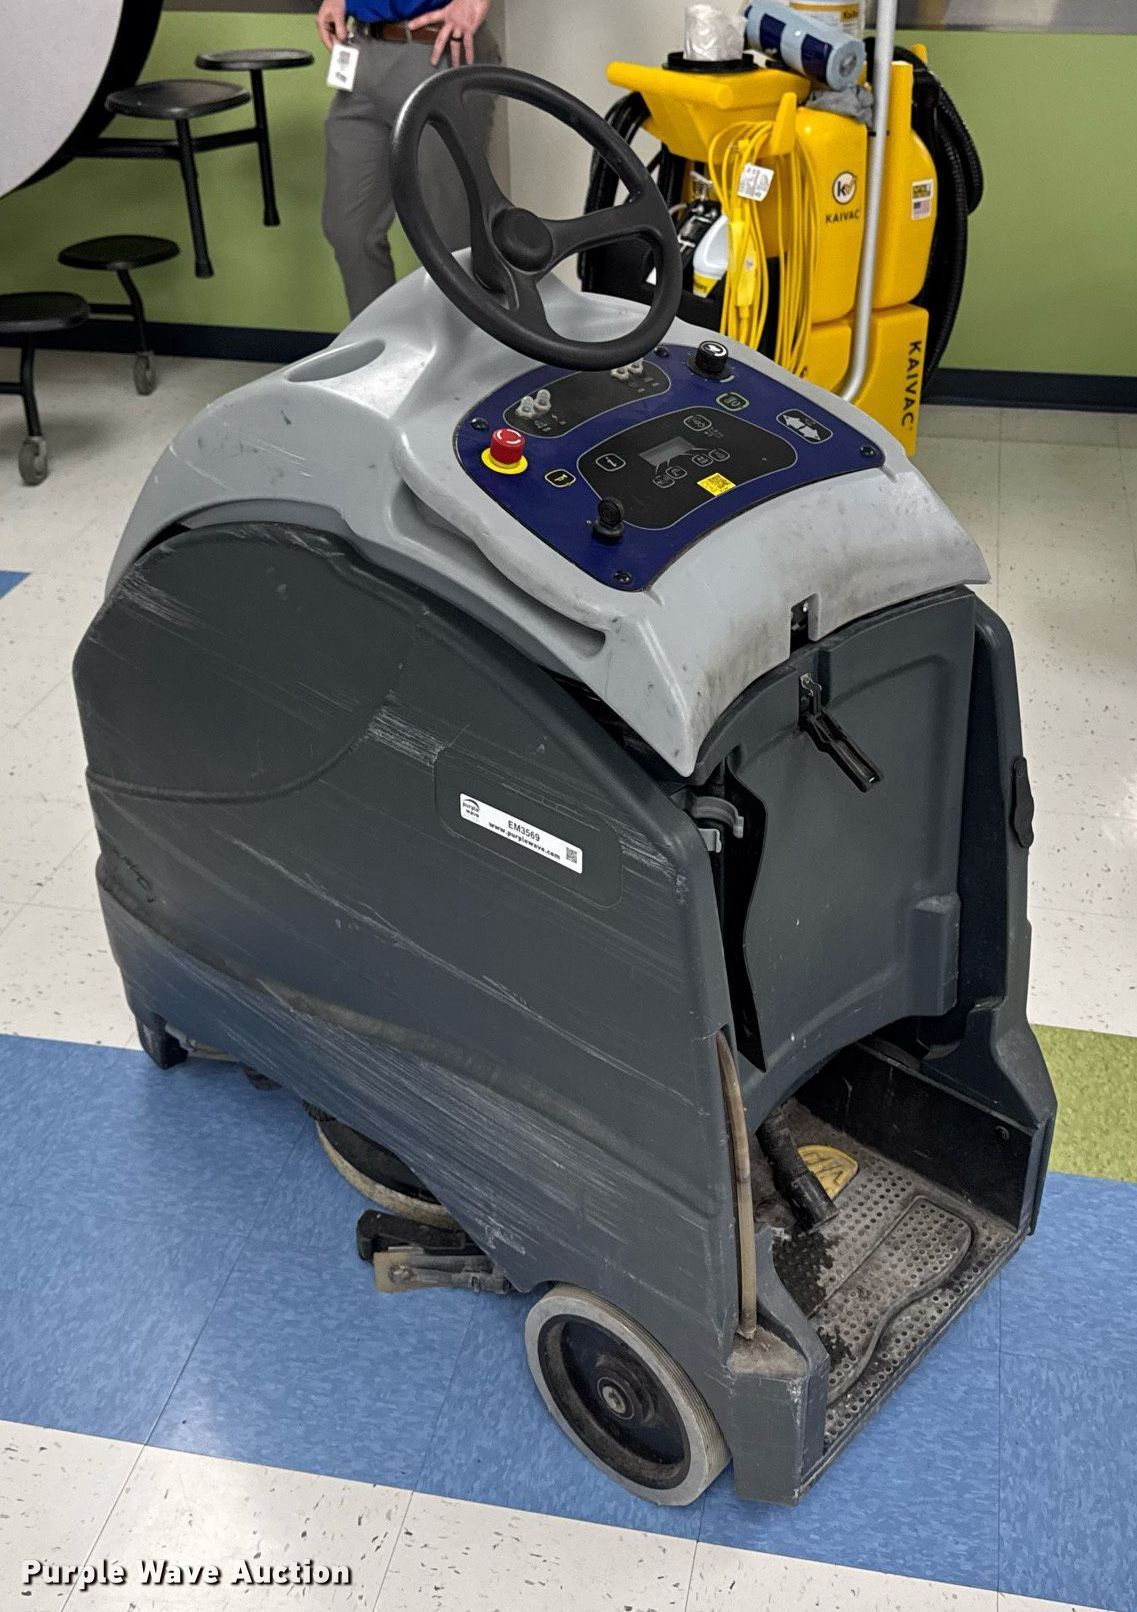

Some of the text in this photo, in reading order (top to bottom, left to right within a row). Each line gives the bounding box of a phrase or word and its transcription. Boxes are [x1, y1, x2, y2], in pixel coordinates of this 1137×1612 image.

[825, 210, 860, 224] KAIVAC
[901, 340, 922, 427] KAIVAC
[488, 821, 561, 860] www.purplewave.com
[508, 820, 541, 842] EM3569
